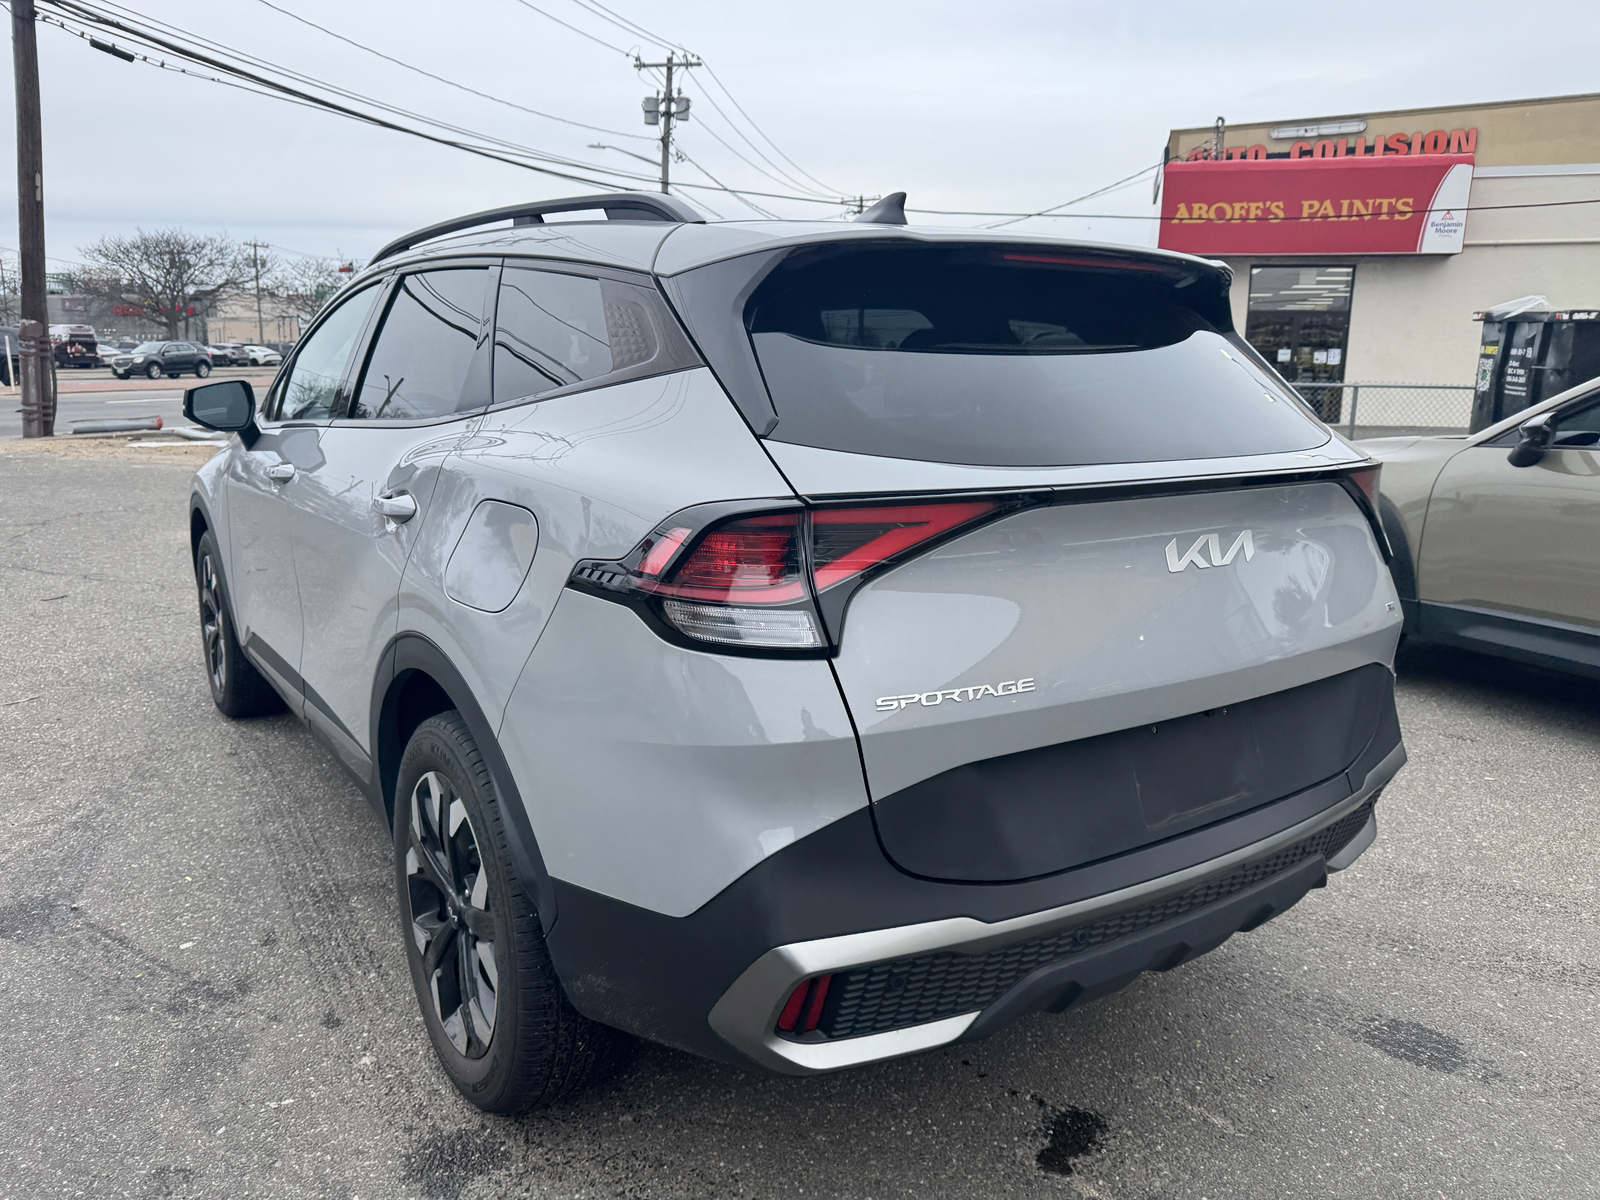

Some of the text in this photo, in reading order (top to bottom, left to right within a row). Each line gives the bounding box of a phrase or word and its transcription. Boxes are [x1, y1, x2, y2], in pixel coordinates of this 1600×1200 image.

[1290, 128, 1478, 159] COLLISION
[1171, 198, 1414, 224] ABOFF'S PAINTS
[1165, 530, 1255, 573] KIA
[875, 677, 1036, 711] SPORTAGE
